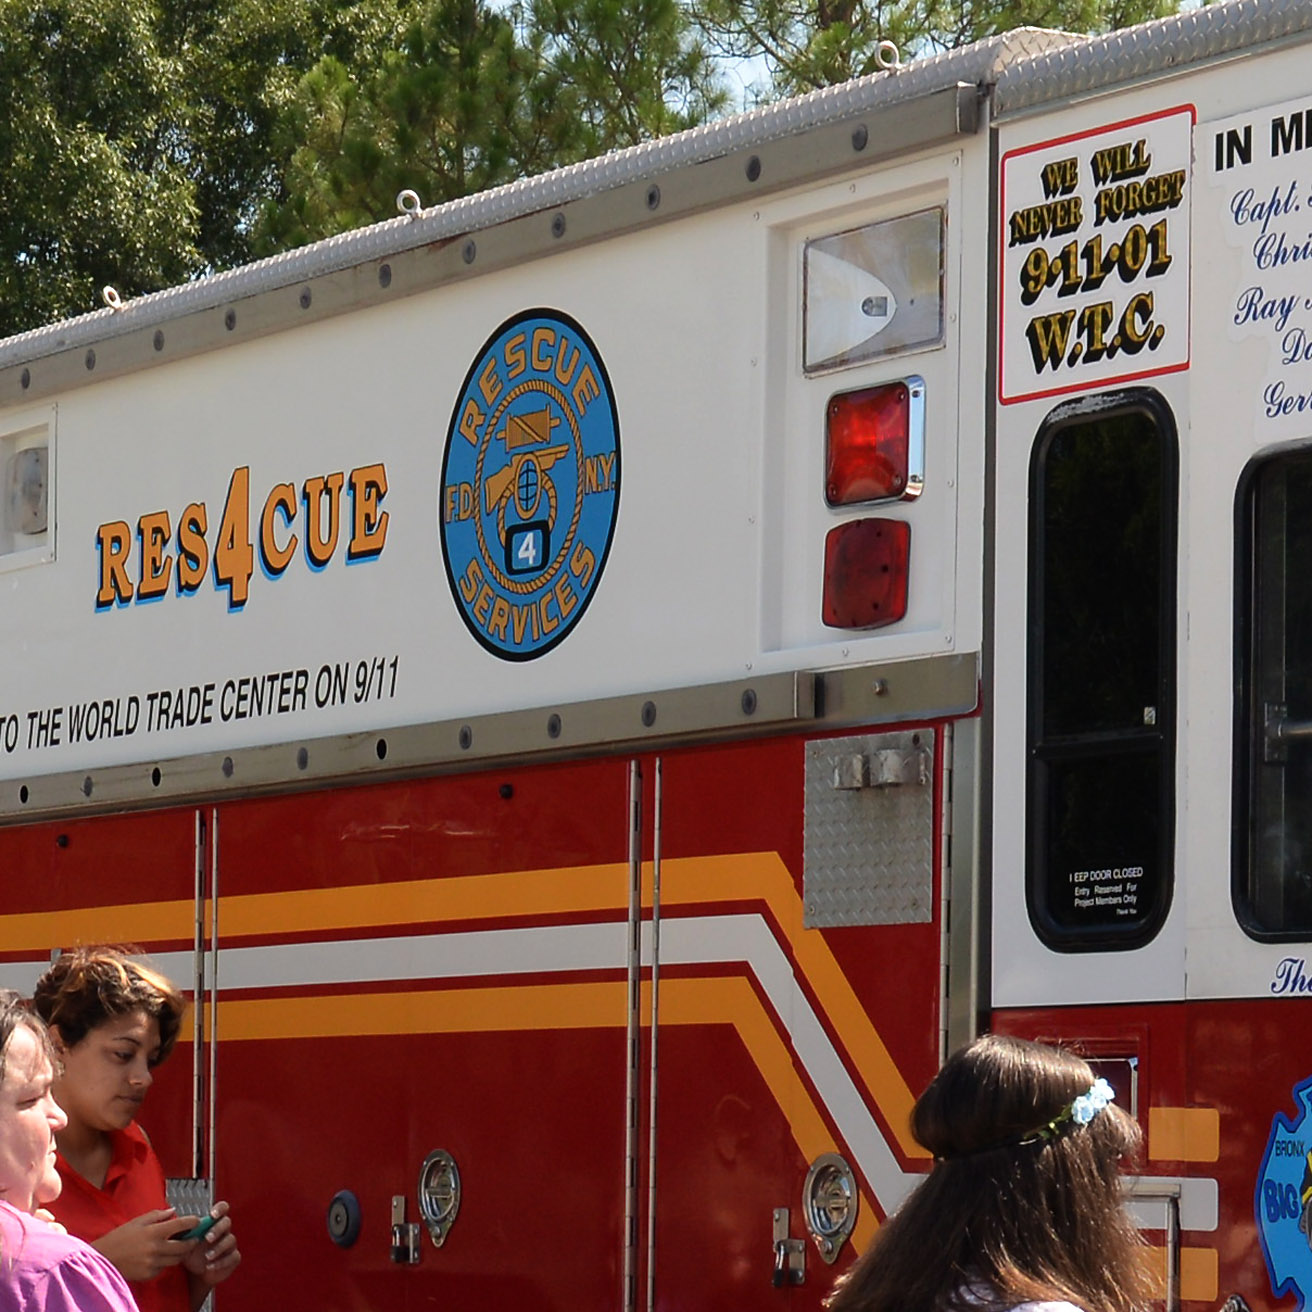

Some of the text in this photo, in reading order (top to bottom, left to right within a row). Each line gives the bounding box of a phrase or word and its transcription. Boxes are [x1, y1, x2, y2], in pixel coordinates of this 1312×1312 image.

[1042, 139, 1151, 199] WE WILL
[1214, 128, 1252, 171] IN
[1009, 170, 1186, 248] NEVER FORGET
[1229, 183, 1301, 231] Capt.
[1233, 285, 1299, 326] Ray
[1025, 291, 1165, 374] W.T.C.
[458, 326, 601, 447] RESCUE
[583, 451, 617, 495] N.Y.
[95, 461, 390, 614] RES4CUE
[518, 532, 536, 565] 4
[458, 541, 597, 646] SERVICES
[26, 708, 64, 751] THE
[67, 699, 139, 743] WORLD
[145, 682, 215, 734] TRADE
[219, 669, 312, 722] CENTER
[313, 664, 348, 709] ON
[353, 655, 400, 704] 9/11
[1090, 869, 1112, 881] DOOR
[1113, 866, 1143, 879] CLOSED
[1275, 1139, 1305, 1158] BRONX
[1263, 1178, 1301, 1224] BIG
